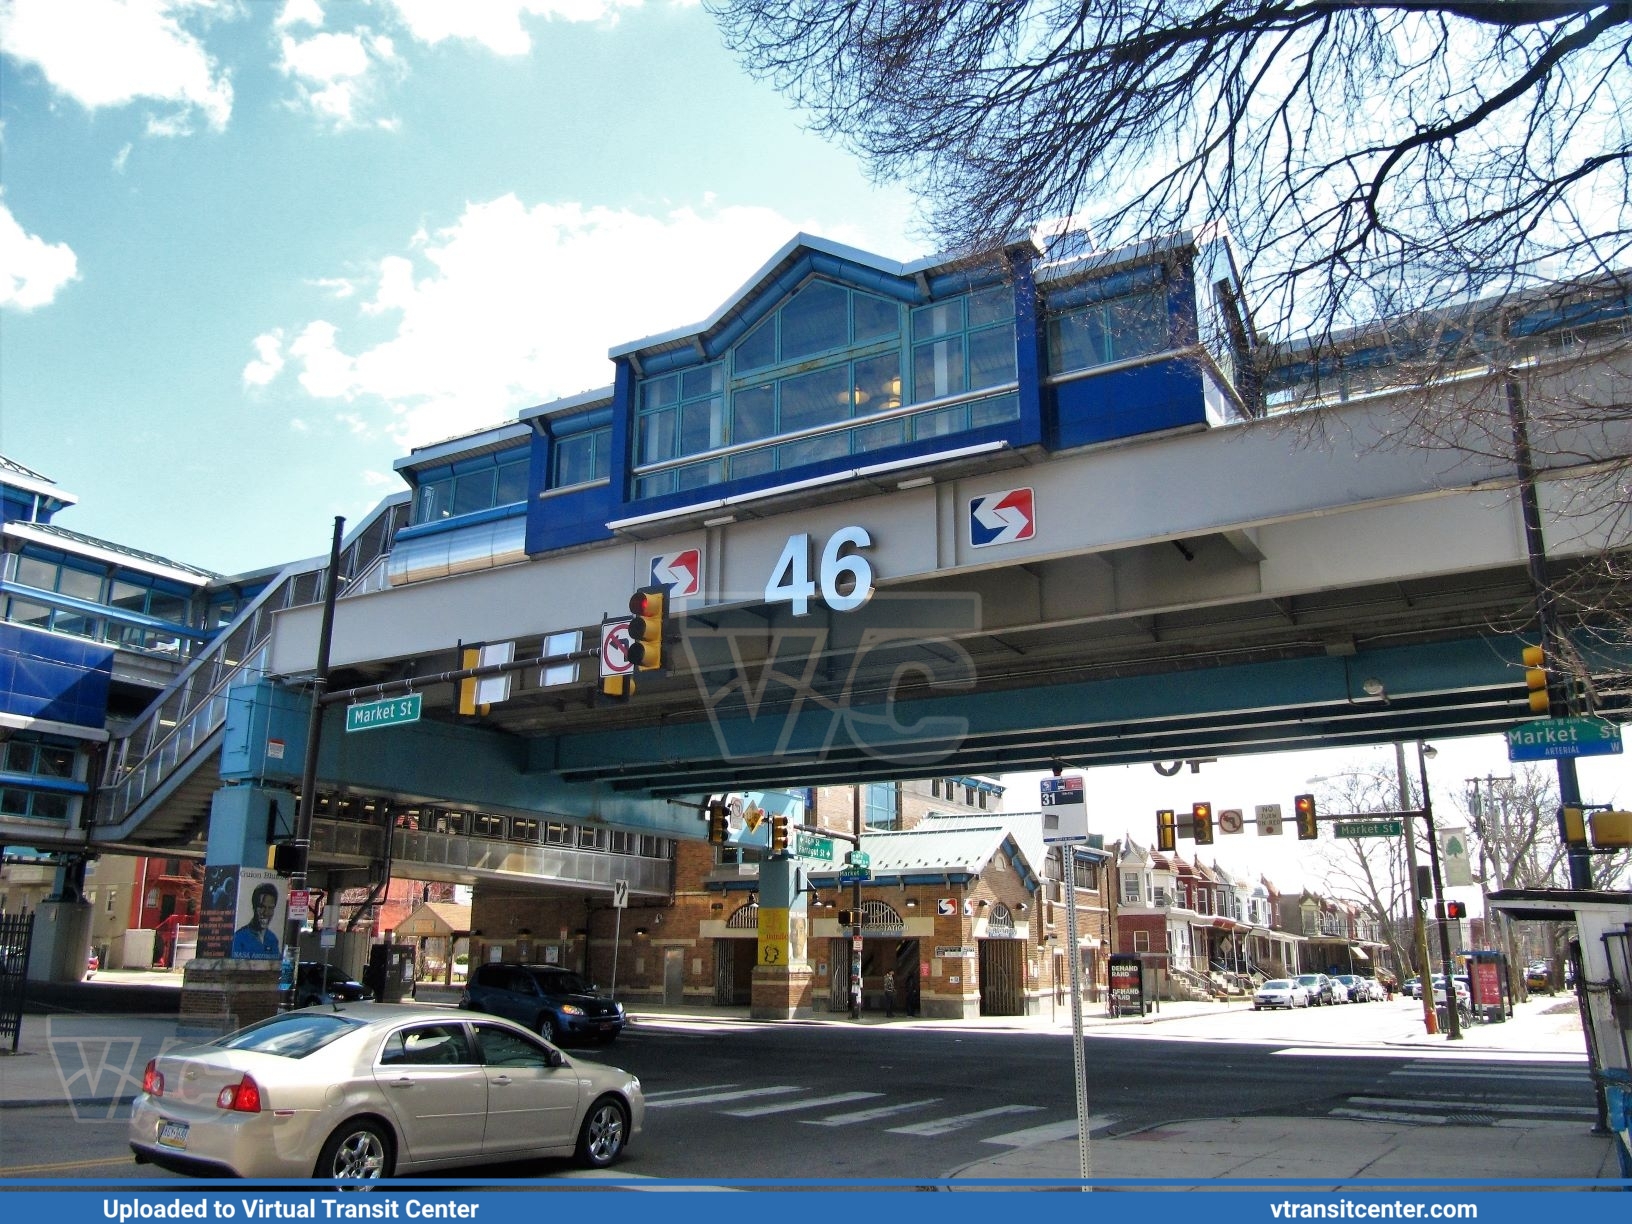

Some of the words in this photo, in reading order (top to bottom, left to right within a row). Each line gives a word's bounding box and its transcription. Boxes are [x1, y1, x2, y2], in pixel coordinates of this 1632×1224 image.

[765, 525, 875, 617] 46
[355, 703, 395, 724] Market
[400, 701, 412, 716] St
[1507, 726, 1578, 745] Market
[1600, 725, 1619, 739] St
[1545, 745, 1580, 756] ARTERIAL
[1610, 742, 1620, 752] W
[1042, 792, 1056, 806] 31
[1262, 805, 1273, 813] NO
[1341, 824, 1379, 834] Market
[1382, 823, 1394, 833] St
[840, 869, 860, 877] Market
[233, 951, 251, 959] NASA
